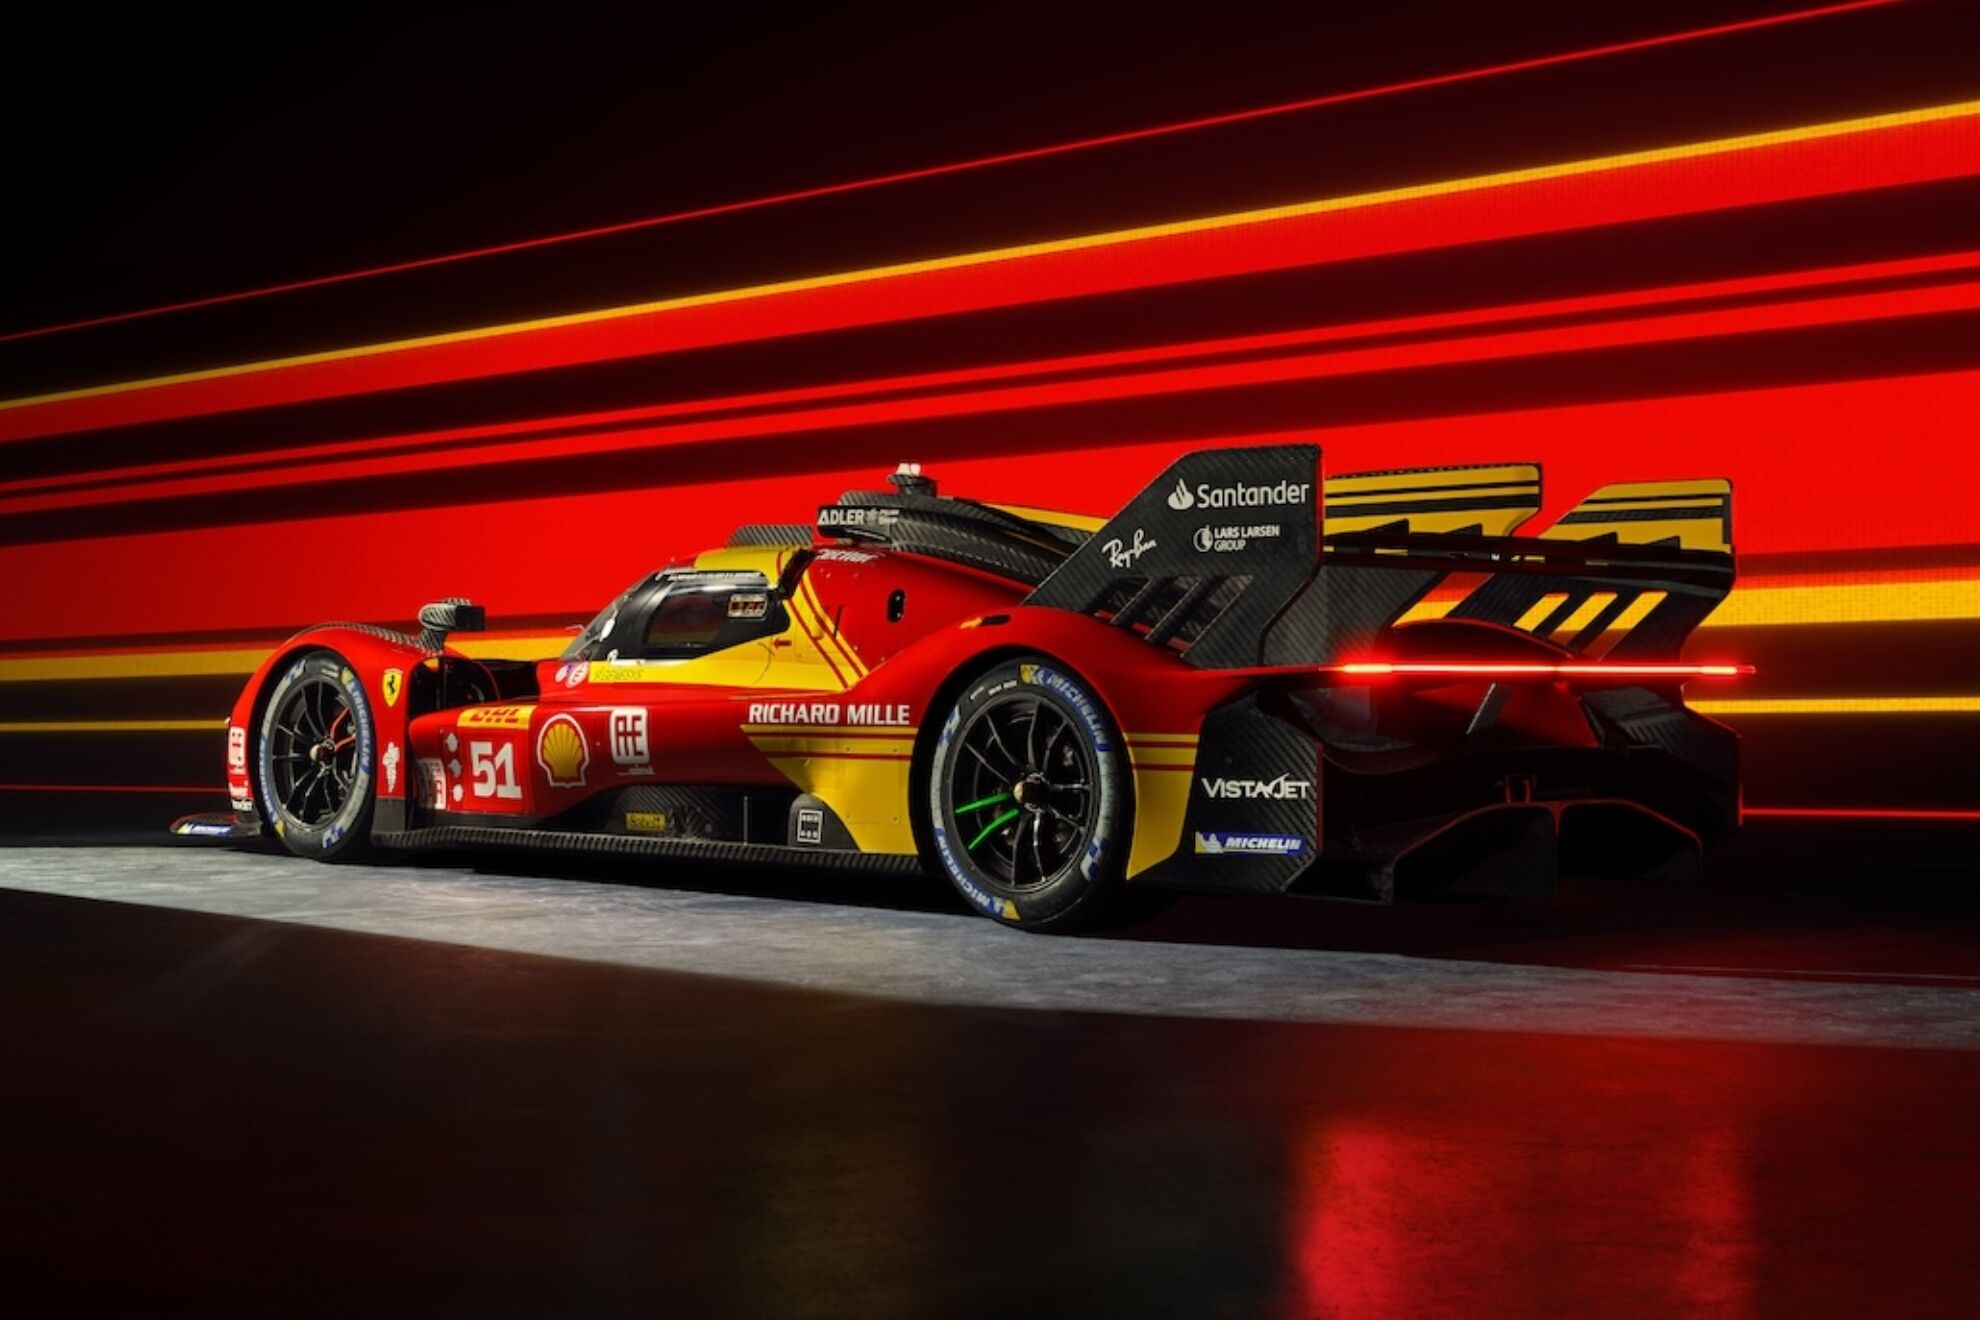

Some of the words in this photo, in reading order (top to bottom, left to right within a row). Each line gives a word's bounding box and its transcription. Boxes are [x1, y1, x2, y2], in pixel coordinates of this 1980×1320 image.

[1197, 480, 1310, 508] Santander
[817, 509, 865, 526] ADLER
[1214, 526, 1239, 539] LARS
[1240, 525, 1281, 538] LARSEN
[1214, 540, 1246, 552] GROUP
[749, 703, 840, 724] RICHARD
[847, 704, 910, 725] MILLE
[1045, 672, 1108, 745] MICHELIN
[470, 741, 523, 799] 51
[1225, 836, 1302, 850] MICHELIN
